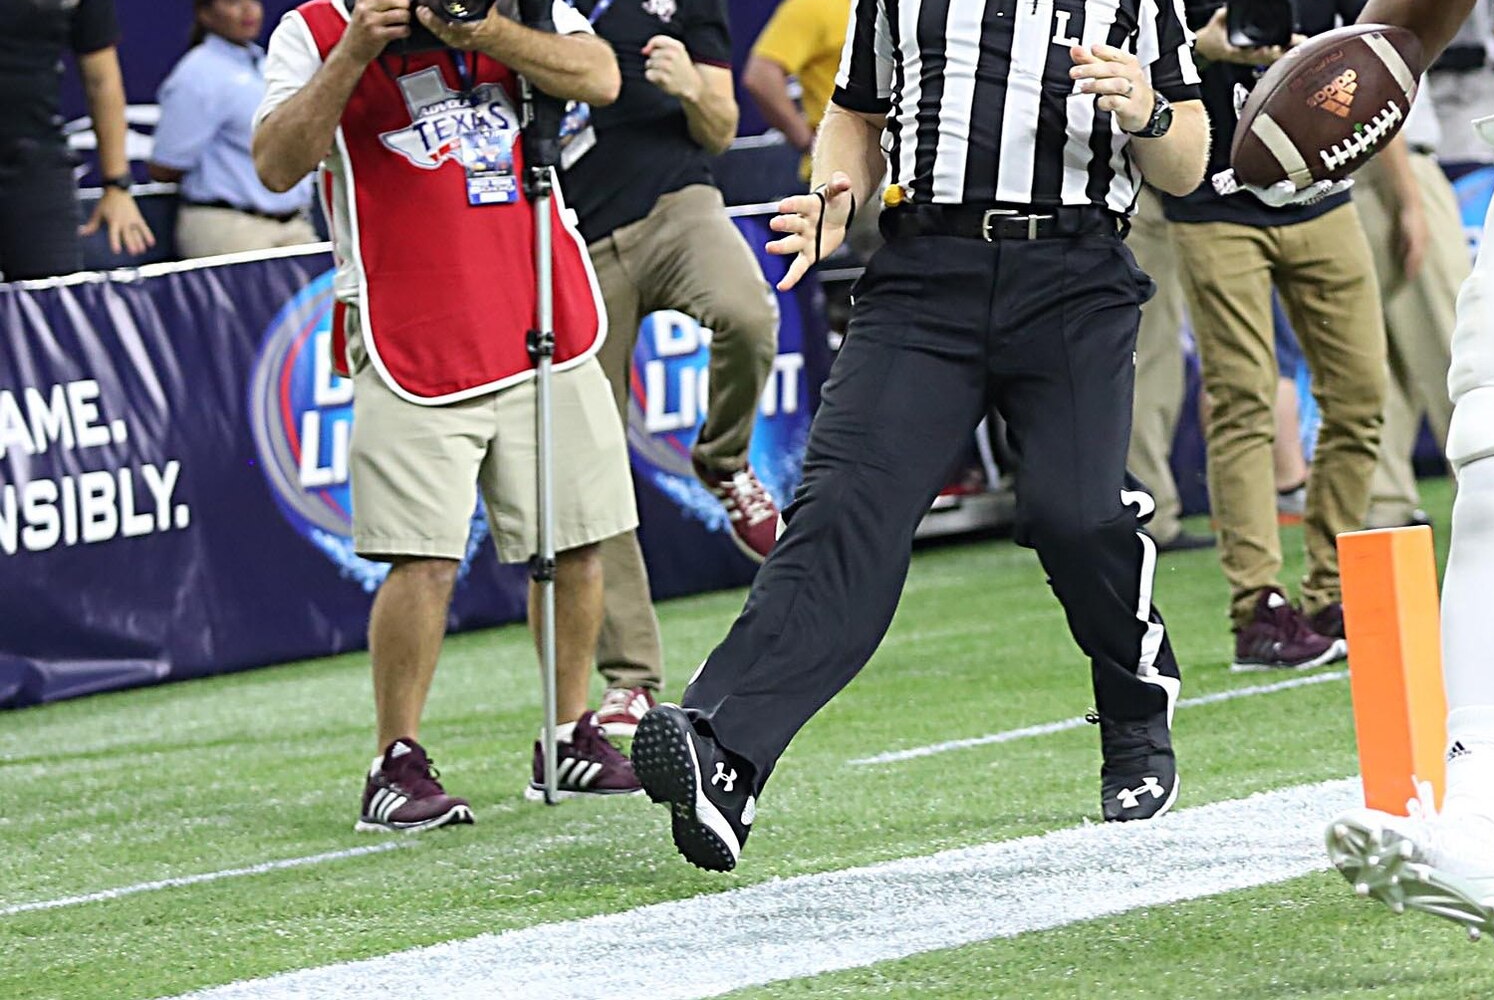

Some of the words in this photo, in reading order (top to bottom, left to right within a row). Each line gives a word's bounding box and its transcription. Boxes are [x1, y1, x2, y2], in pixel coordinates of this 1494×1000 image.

[1052, 10, 1079, 47] L
[412, 102, 510, 151] TEXAS
[645, 352, 804, 434] LIT
